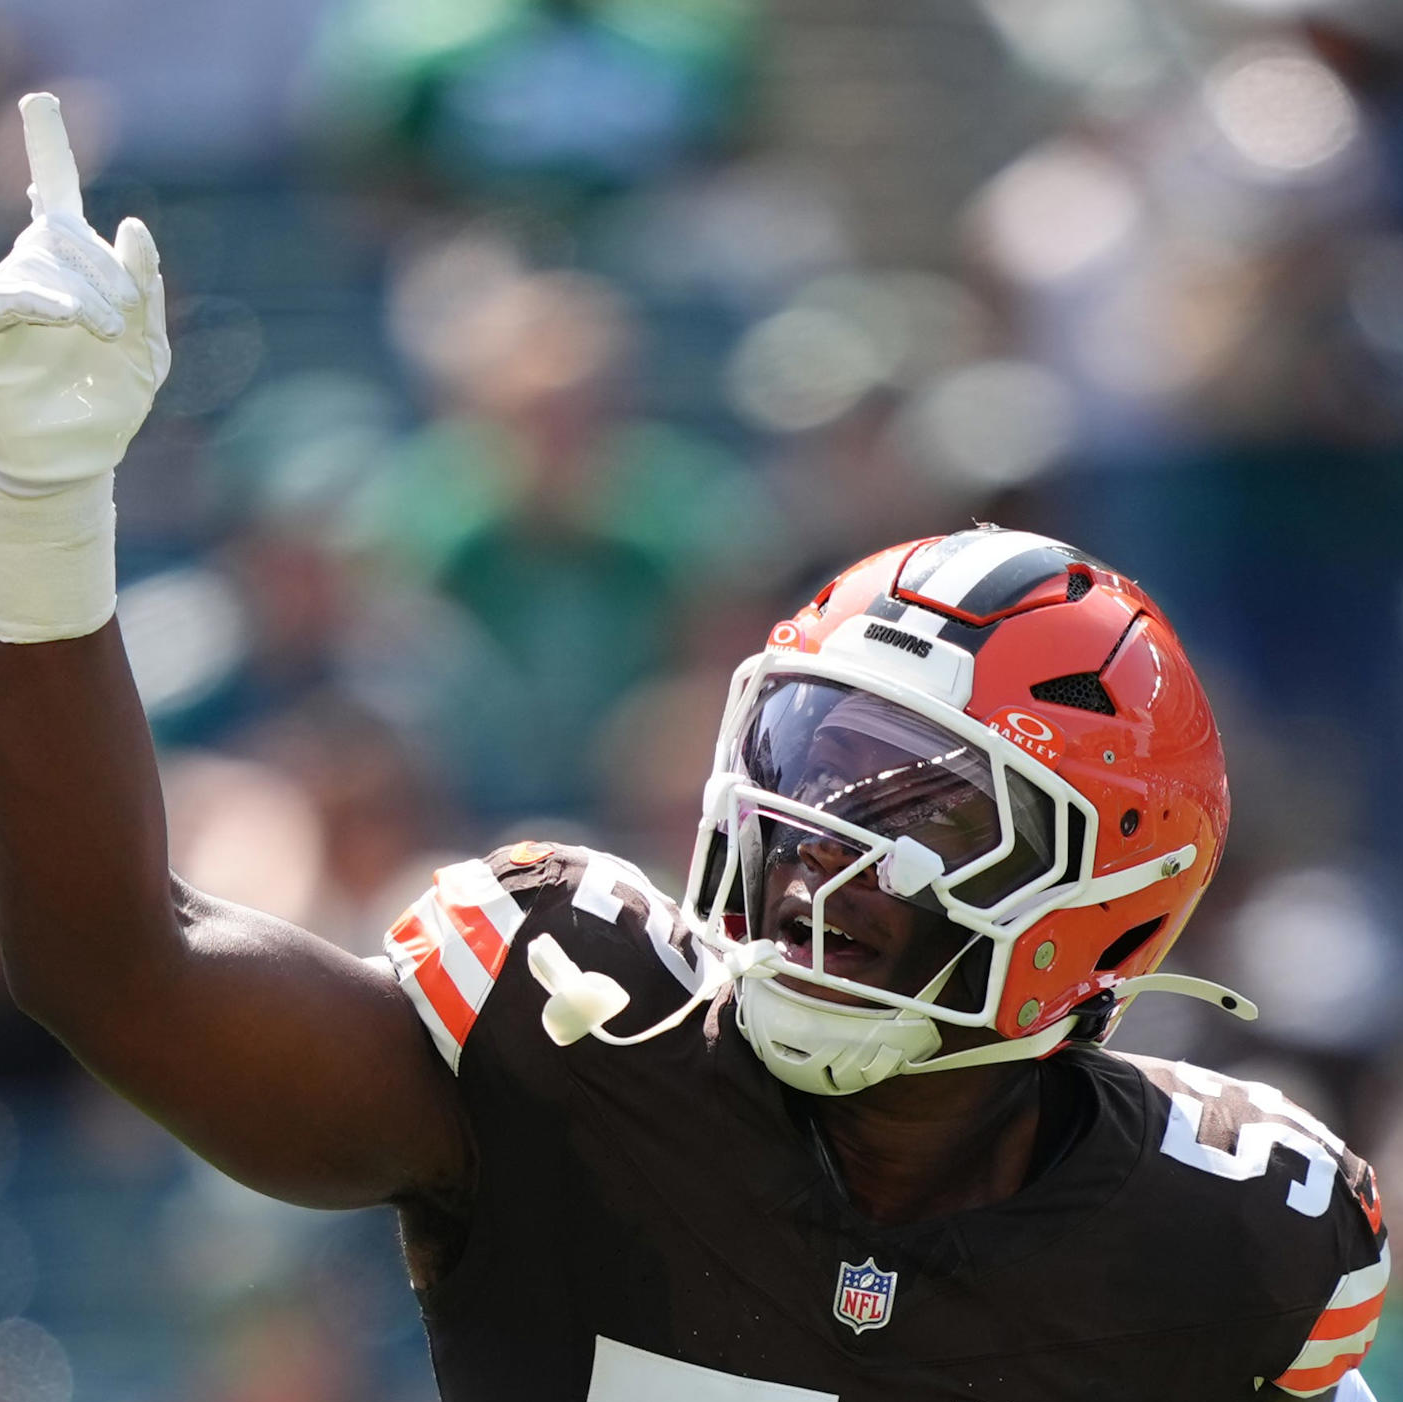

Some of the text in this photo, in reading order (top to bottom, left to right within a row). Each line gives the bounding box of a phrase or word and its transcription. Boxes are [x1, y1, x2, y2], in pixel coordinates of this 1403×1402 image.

[863, 622, 934, 659] BROWNS
[989, 721, 1058, 760] OAKLEY
[842, 1289, 882, 1321] NFL
